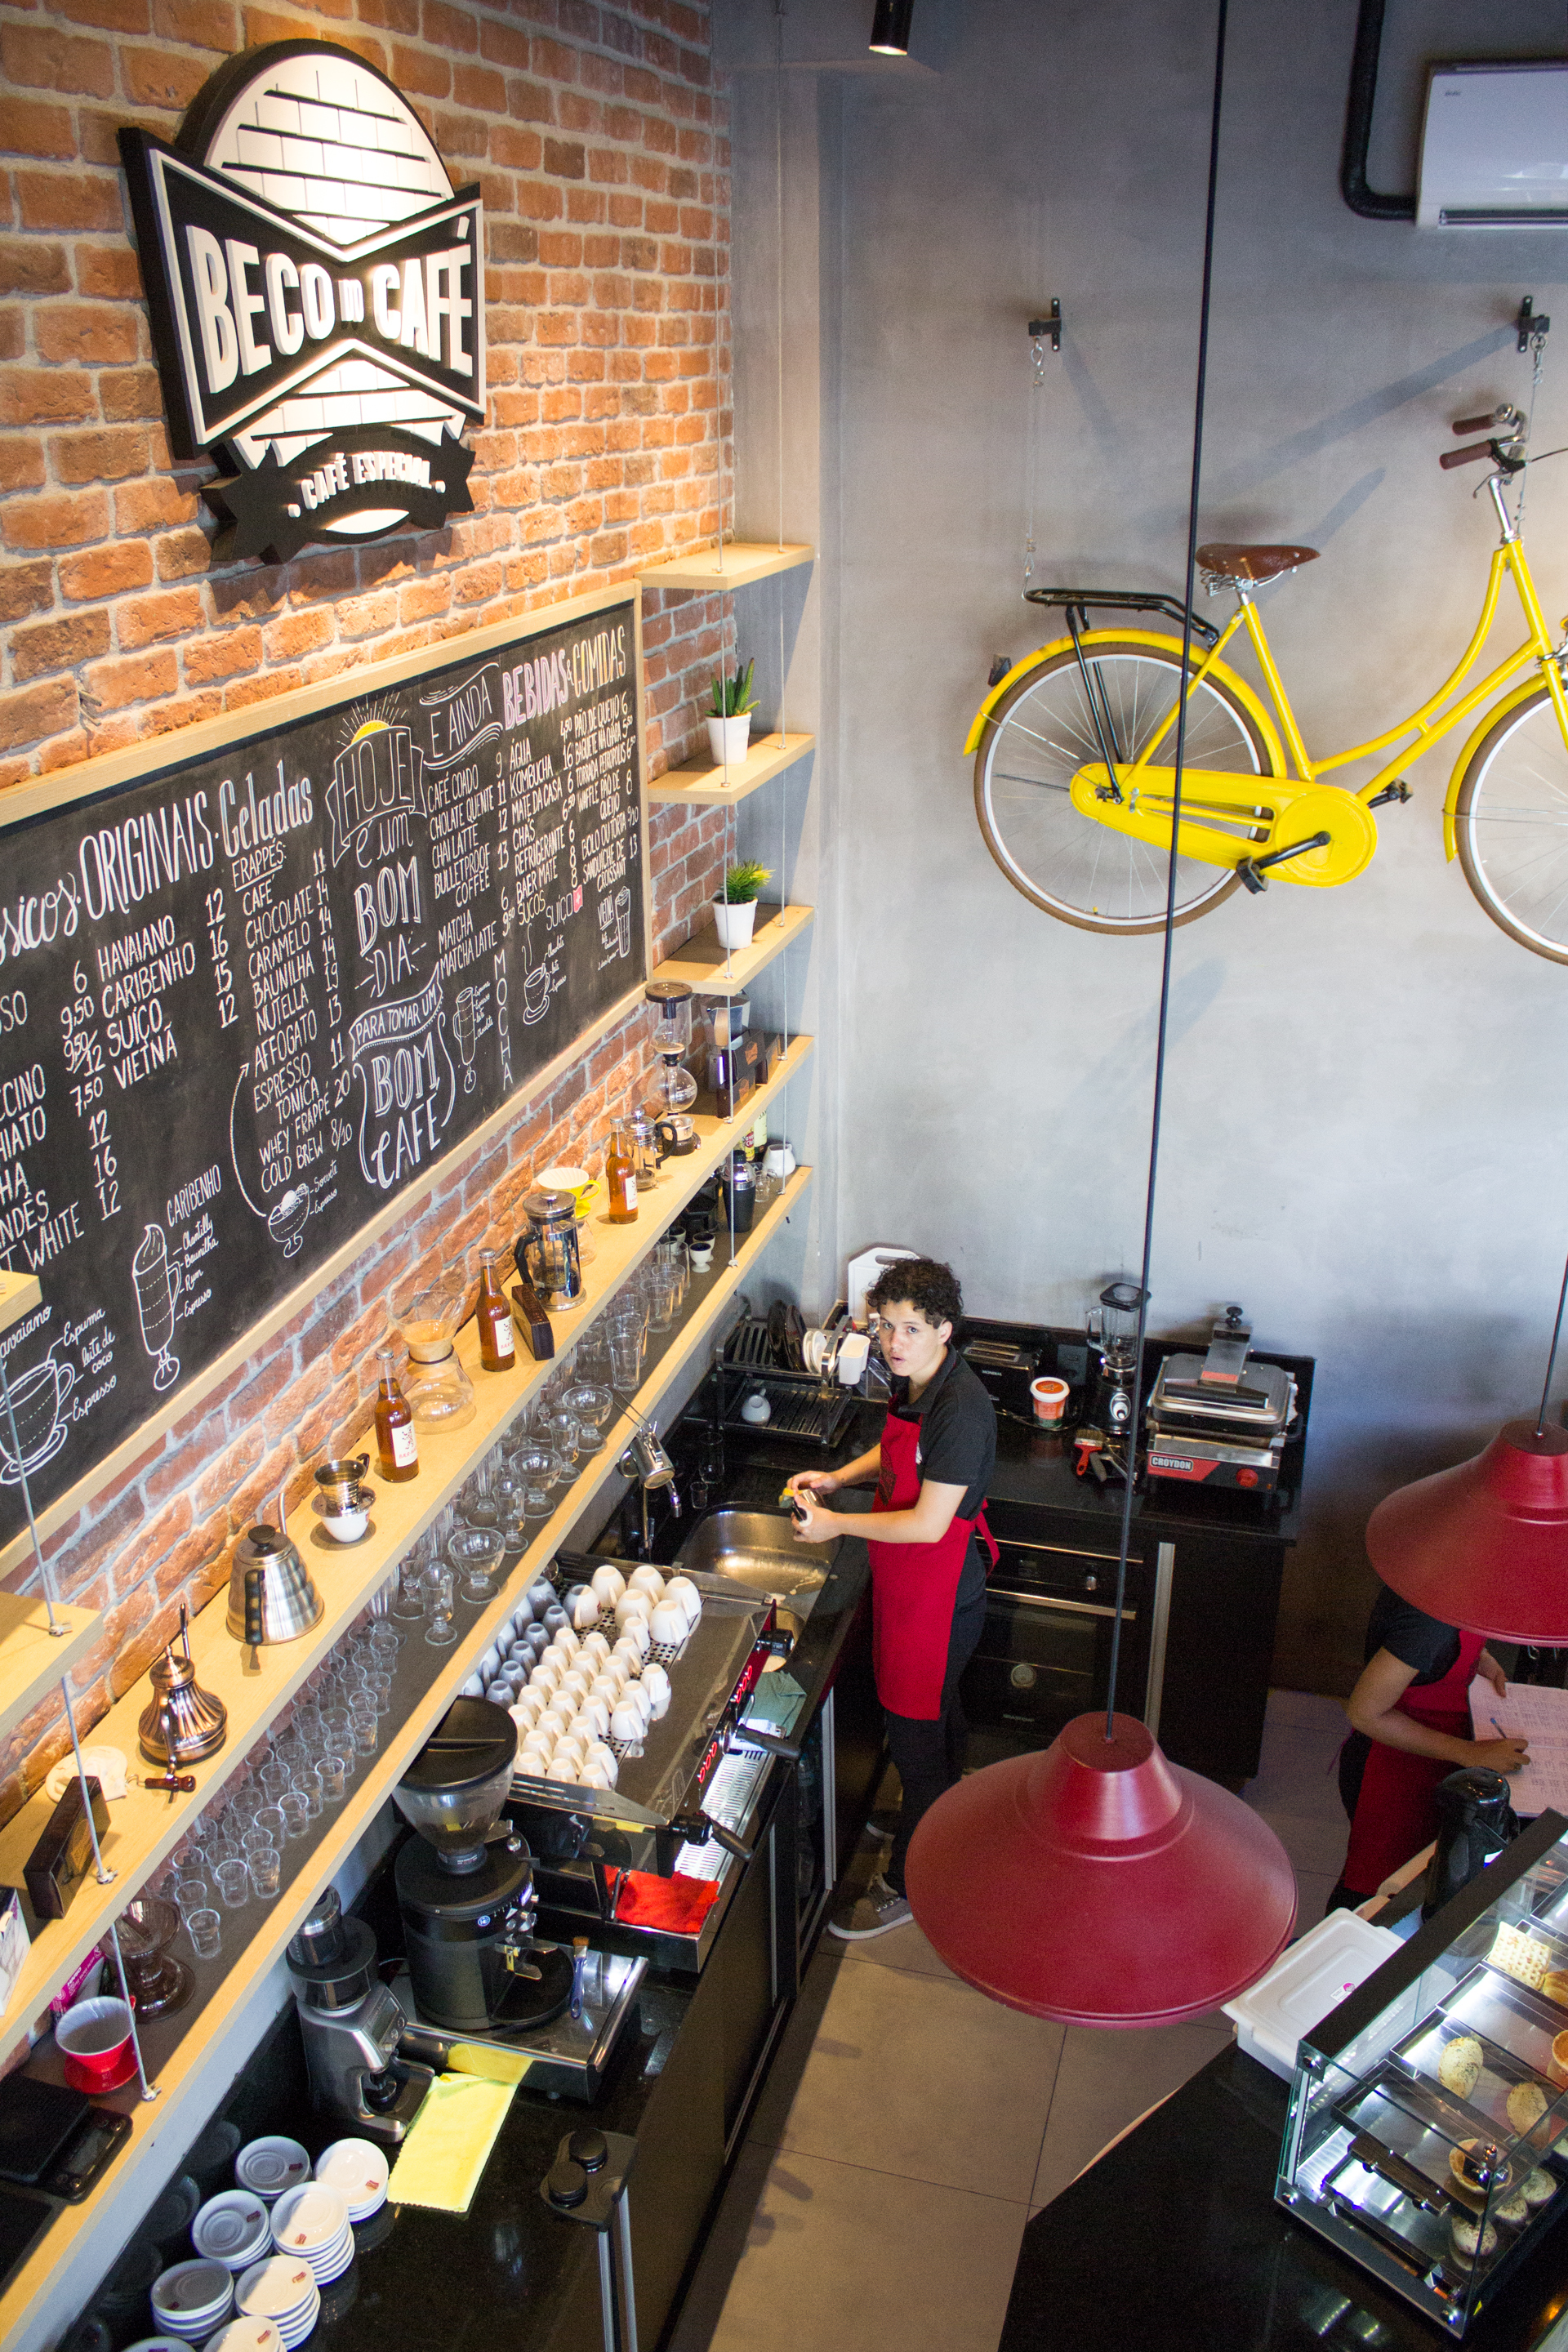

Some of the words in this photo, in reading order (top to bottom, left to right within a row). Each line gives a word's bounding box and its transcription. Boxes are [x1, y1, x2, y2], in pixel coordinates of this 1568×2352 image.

[186, 225, 336, 394] BECO
[338, 278, 365, 323] DO
[372, 216, 474, 378] CAFÉ
[301, 452, 350, 510] CAFÉ
[354, 451, 434, 491] ESPECIAL
[502, 648, 569, 731] BEBIDAS
[572, 625, 626, 698] COMIDAS
[430, 712, 444, 759] E
[449, 675, 492, 751] AINDA
[574, 707, 587, 739] PÃO
[588, 706, 598, 733] DE
[598, 694, 620, 728] QUEIJO
[621, 691, 628, 715] 6
[341, 732, 412, 830] HOJE
[427, 771, 451, 813] CAFÉ
[452, 764, 479, 800] COADO
[496, 751, 503, 779] 9
[510, 737, 532, 772] ÁGUA
[510, 754, 554, 799] KOMBUCHA
[563, 742, 573, 771] 16
[612, 769, 621, 792] DE
[626, 768, 633, 795] 8
[219, 760, 314, 858] Geladas
[430, 802, 466, 841] CHOLATE
[466, 785, 495, 823] QUENTE
[497, 779, 507, 806] 11
[511, 793, 532, 826] MATE
[532, 786, 544, 815] DA
[543, 776, 563, 808] CASA
[568, 771, 574, 794] 6
[599, 791, 620, 821] QUEIJO
[80, 791, 214, 920] ORIGINAIS
[376, 812, 414, 861] um
[432, 838, 452, 870] CHAI
[452, 823, 479, 860] LATTE
[497, 808, 508, 833] 12
[513, 818, 536, 852] CHÁS
[514, 824, 566, 877] REFRIGERANTE
[569, 819, 576, 843] 6
[581, 829, 600, 861] BOLO
[616, 837, 625, 862] DE
[629, 833, 638, 860] 13
[243, 875, 275, 916] CAFÉ
[313, 847, 327, 877] 11
[434, 843, 490, 899] BULLETPROOF
[497, 840, 510, 871] 13
[455, 866, 490, 907] COFFEE
[516, 870, 538, 905] BAER
[538, 855, 559, 888] MATE
[569, 844, 577, 868] 8
[517, 889, 546, 926] SUCOS
[572, 867, 578, 889] 8
[97, 915, 176, 982] HAVAIANO
[205, 888, 226, 927] 12
[245, 884, 314, 950] CHOCOLATE
[314, 875, 330, 906] 14
[354, 856, 422, 957] BOM
[438, 909, 474, 954] MATCHA
[501, 886, 509, 911] 6
[102, 942, 196, 1019] CARIBENHO
[209, 924, 229, 961] 16
[248, 920, 311, 980] CARAMELO
[318, 906, 333, 936] 14
[252, 950, 315, 1009] BAUNILHA
[321, 936, 336, 966] 14
[372, 933, 413, 998] DIA
[439, 942, 474, 980] MATCHA
[474, 920, 498, 960] LATTE
[0, 991, 28, 1035] SO
[73, 959, 88, 994] 6
[214, 960, 233, 996] 15
[255, 982, 310, 1036] NUTELLA
[324, 962, 340, 993] 19
[113, 1021, 178, 1089] VIETNÃ
[218, 993, 238, 1029] 12
[254, 1009, 318, 1078] AFFOGATO
[328, 994, 343, 1028] 13
[355, 1012, 386, 1046] PARA
[387, 1002, 421, 1033] TOMAR
[421, 983, 438, 1017] UM
[0, 1063, 47, 1123] CINO
[253, 1052, 312, 1114] ESPRESSO
[275, 1076, 320, 1125] TONICA
[330, 1031, 345, 1071] 11
[372, 1031, 441, 1118] BOM
[89, 1109, 112, 1150] 12
[259, 1125, 290, 1166] WHEY
[294, 1080, 331, 1140] FRAPPÉ
[334, 1070, 351, 1108] 20
[94, 1145, 118, 1187] 16
[261, 1155, 292, 1193] COLD
[296, 1130, 324, 1169] BREW
[314, 1159, 338, 1193] Sorvete
[99, 1180, 122, 1221] 12
[167, 1164, 222, 1228] CARIBENHO
[314, 1188, 338, 1215] Espresso
[23, 1200, 85, 1272] WHITE
[182, 1212, 214, 1252] Chantilly
[184, 1236, 219, 1269] Baunilha
[184, 1289, 212, 1318] Espresso
[185, 1270, 204, 1293] Rum
[0, 1305, 52, 1360] avaiano
[63, 1307, 106, 1348] Espuma
[81, 1335, 103, 1369] leite
[101, 1325, 116, 1349] de
[91, 1351, 114, 1374] coco
[72, 1374, 118, 1422] Espresso
[1152, 1457, 1192, 1469] CROYDON
